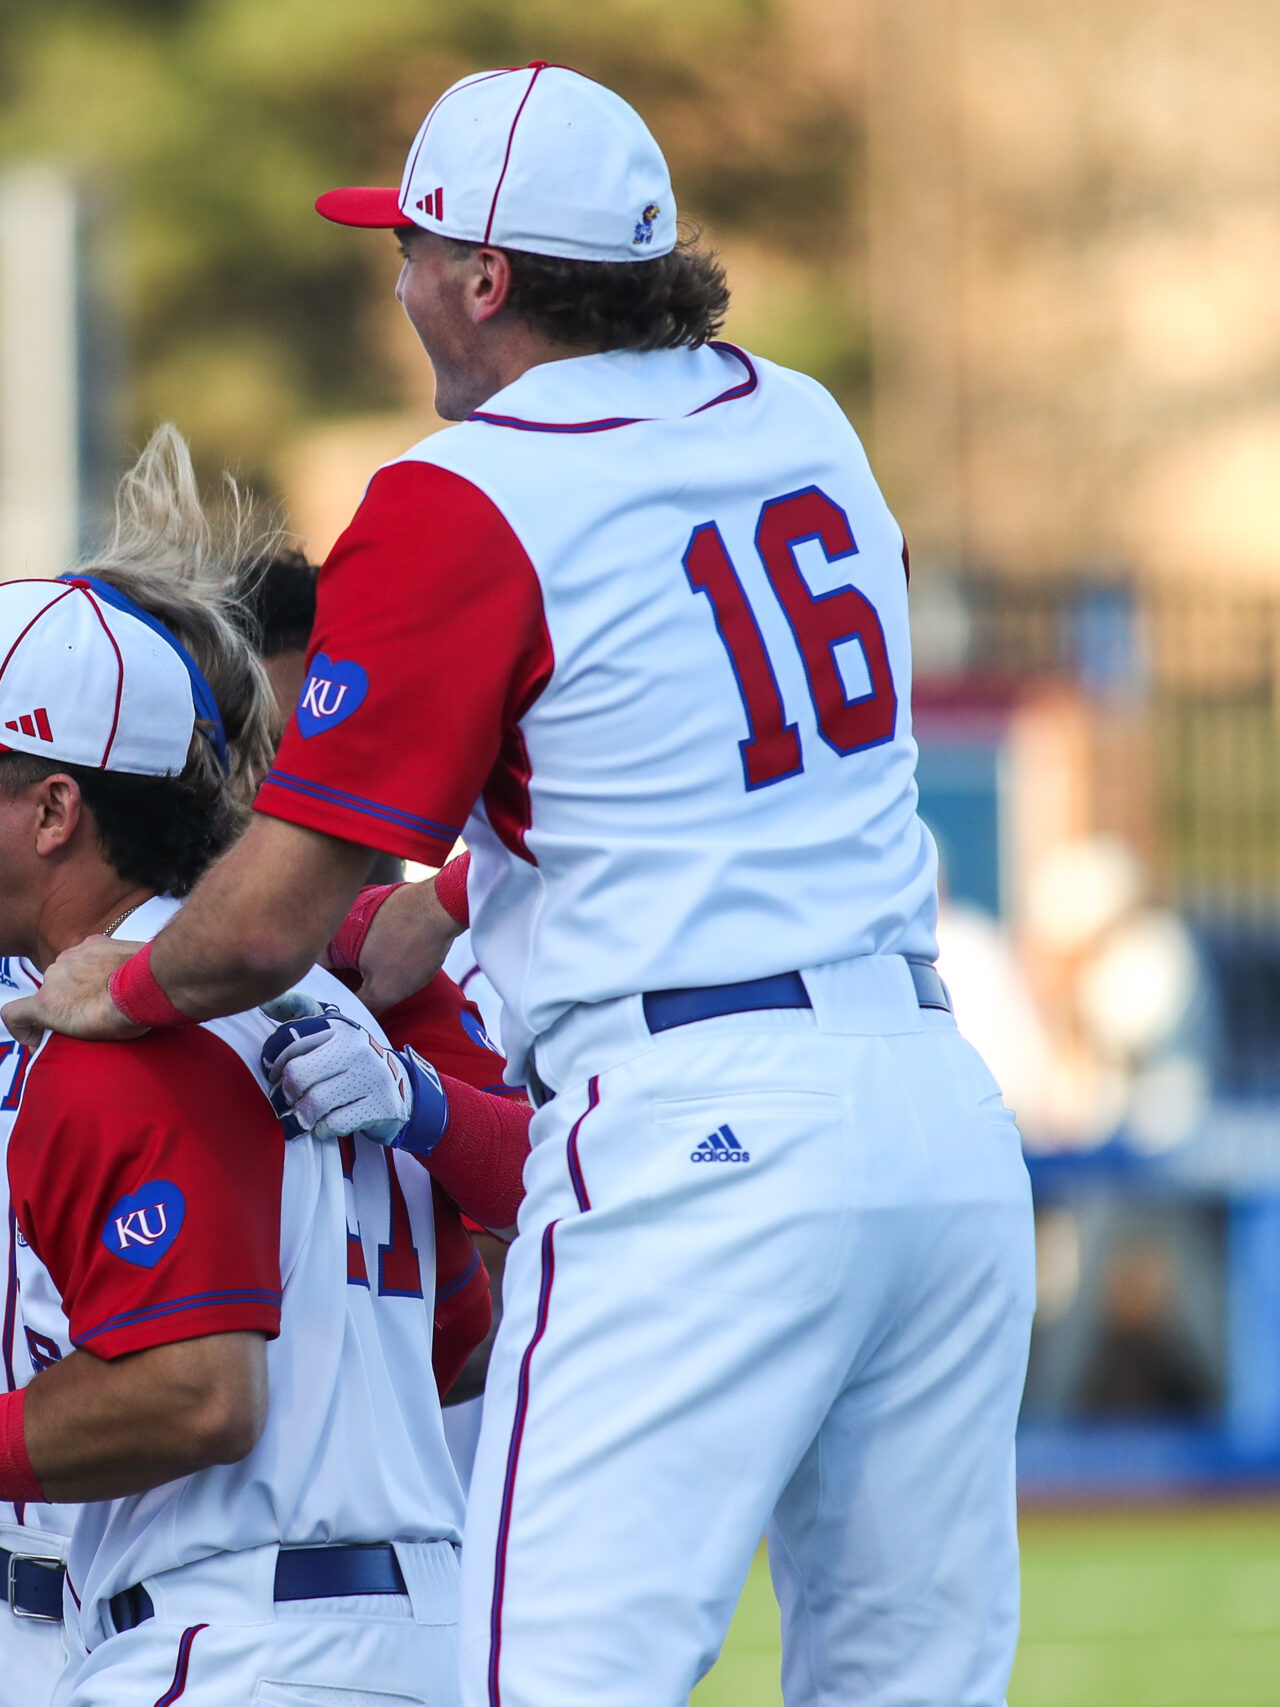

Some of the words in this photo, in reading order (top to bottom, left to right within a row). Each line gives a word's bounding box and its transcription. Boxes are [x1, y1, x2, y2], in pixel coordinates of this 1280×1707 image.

[681, 484, 898, 793] 16
[301, 676, 349, 718] KU
[475, 1030, 505, 1060] K
[690, 1148, 750, 1163] adidas
[114, 1202, 167, 1250] KU
